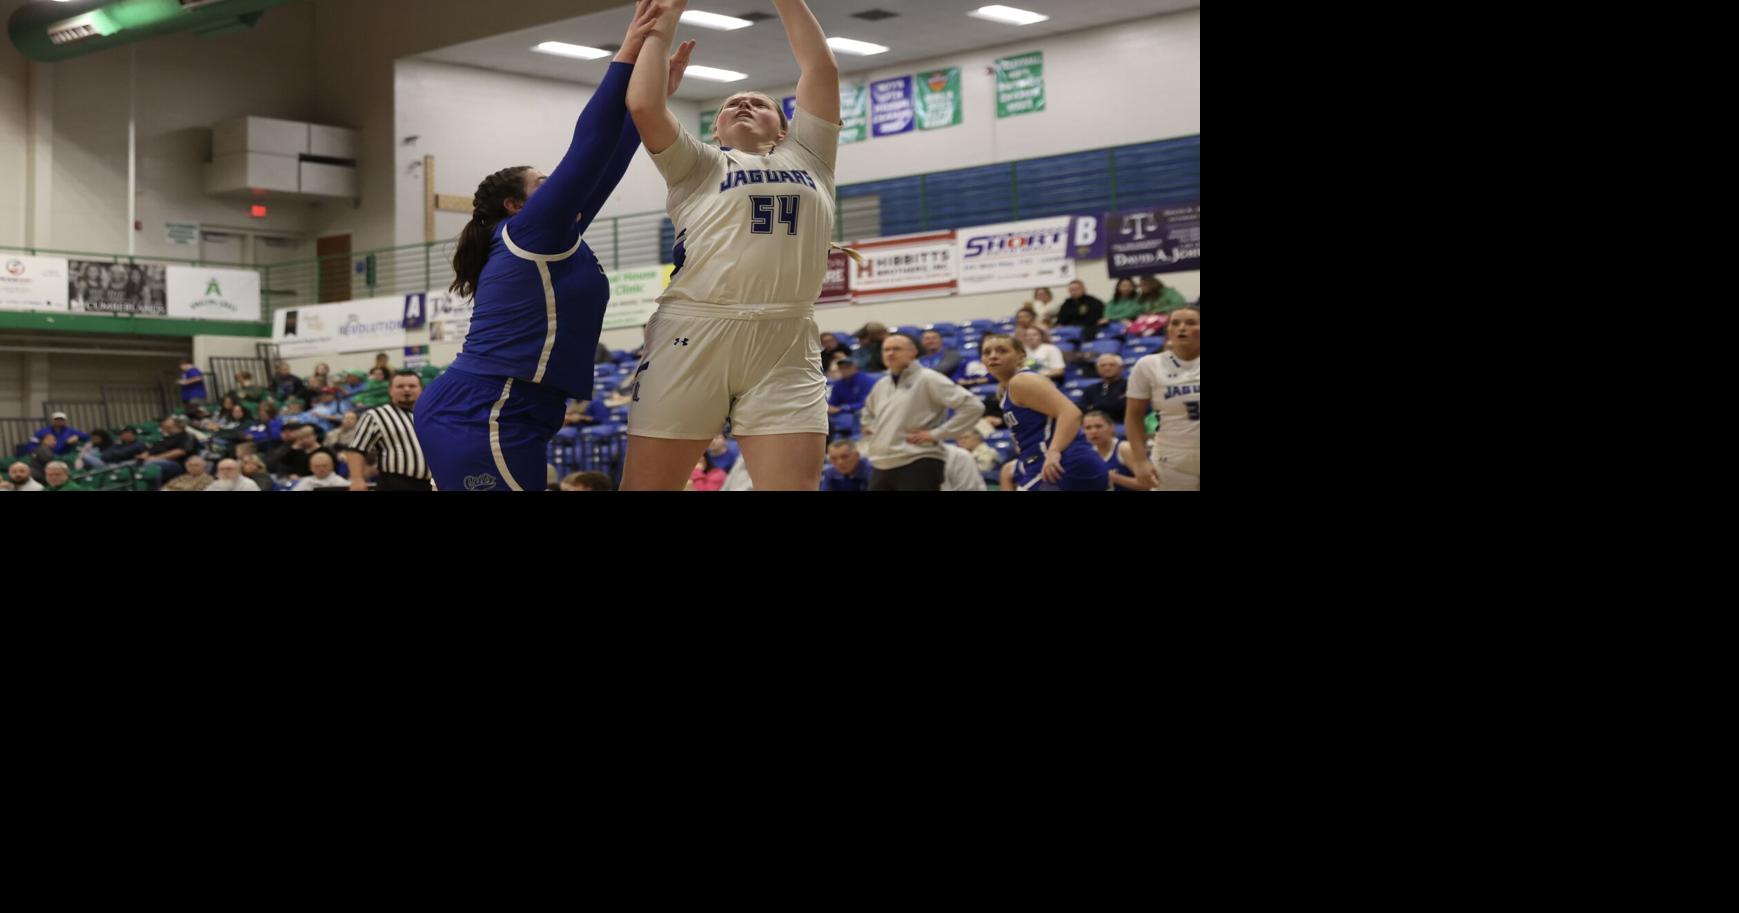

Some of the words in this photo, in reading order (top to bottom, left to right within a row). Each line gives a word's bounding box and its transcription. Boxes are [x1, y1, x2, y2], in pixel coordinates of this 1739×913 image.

[720, 169, 817, 193] JAGUARS
[749, 195, 800, 235] 54
[1074, 216, 1097, 246] B
[877, 250, 949, 266] HIBBITTS
[405, 294, 421, 319] A
